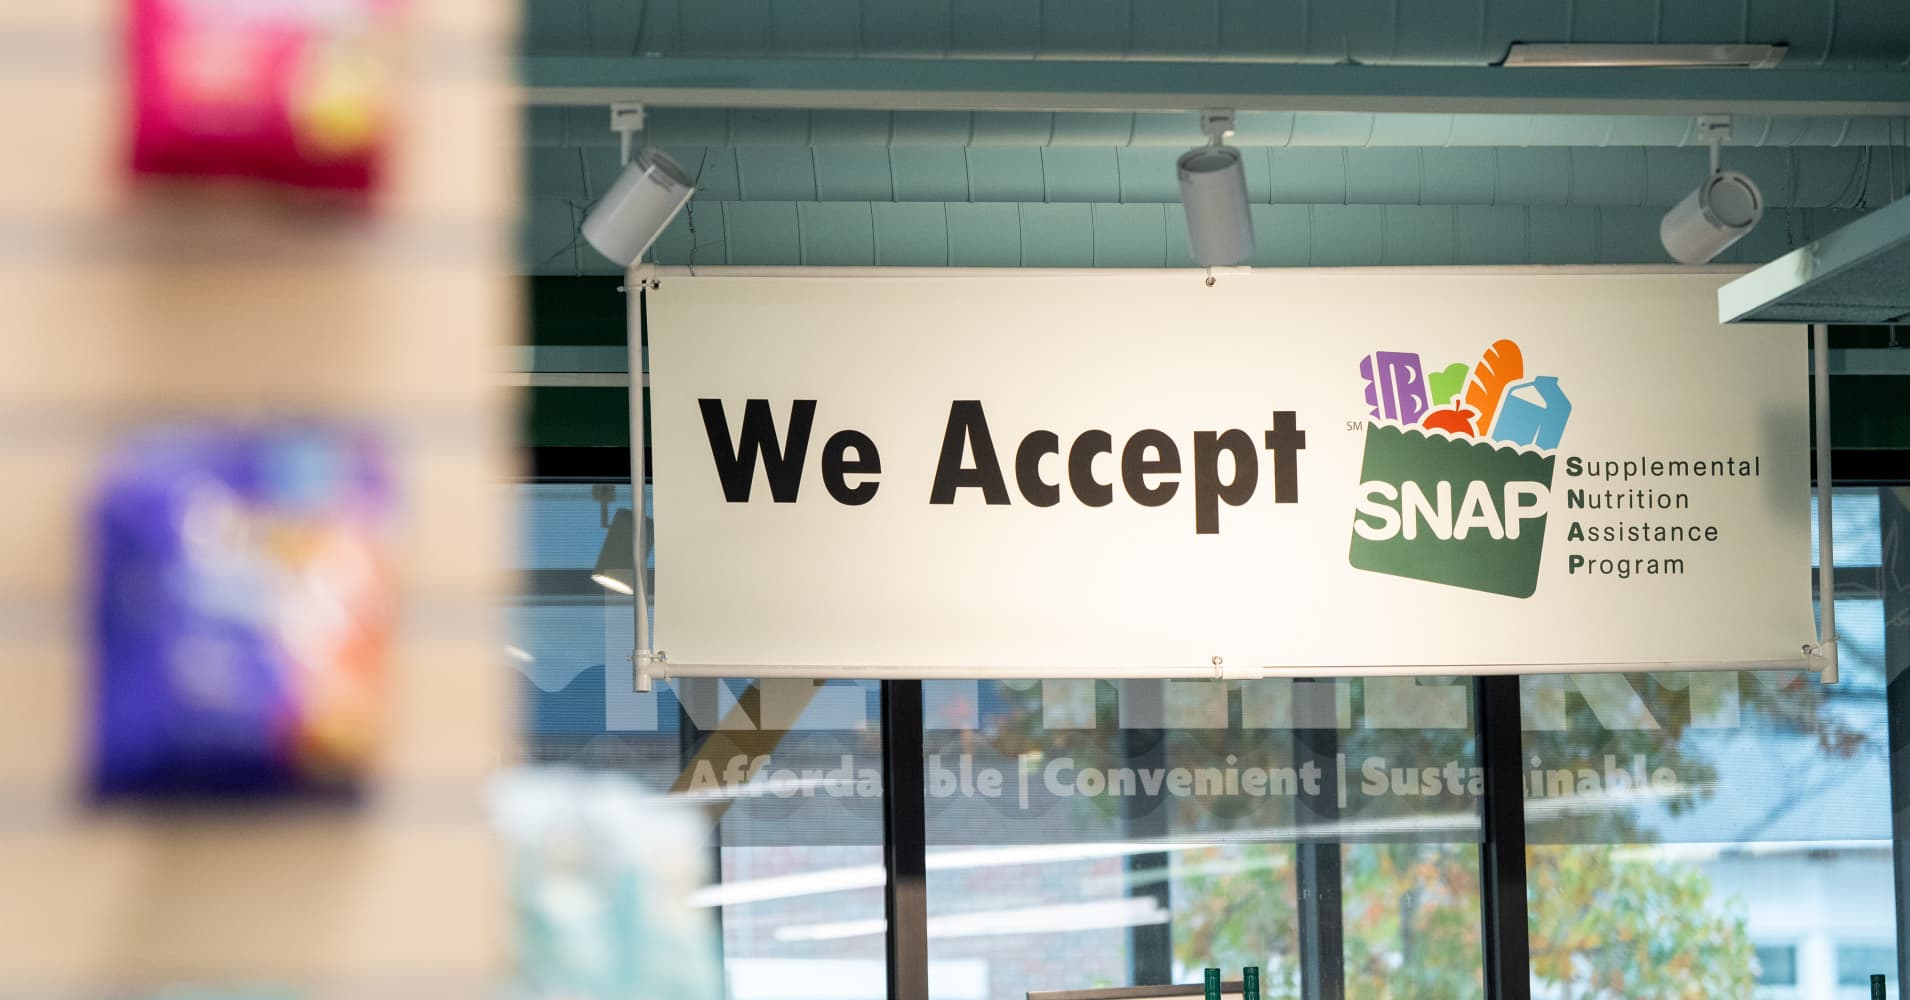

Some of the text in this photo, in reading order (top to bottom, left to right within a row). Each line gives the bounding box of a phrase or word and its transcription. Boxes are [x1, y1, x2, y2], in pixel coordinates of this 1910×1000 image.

[1346, 420, 1363, 432] SM
[697, 398, 1306, 535] We Accept
[1566, 456, 1760, 482] Supplemental
[1353, 480, 1553, 541] SNAP
[1567, 488, 1689, 509] Nutrition
[1567, 521, 1718, 542] Assistance
[1568, 554, 1684, 579] Program
[1043, 753, 1321, 797] Convenient
